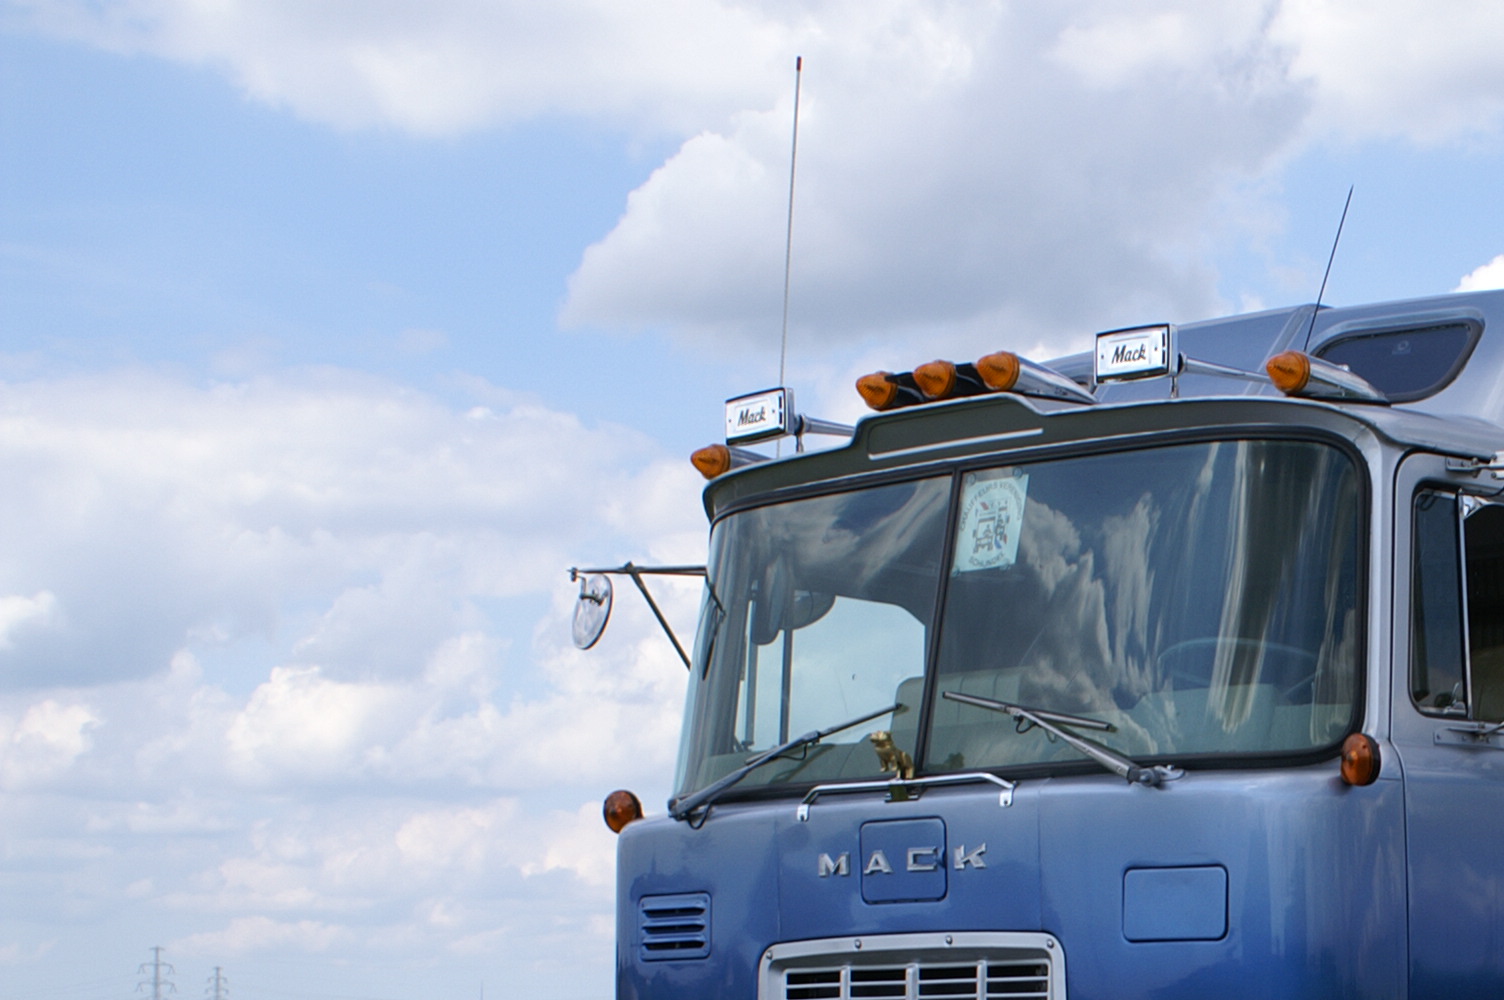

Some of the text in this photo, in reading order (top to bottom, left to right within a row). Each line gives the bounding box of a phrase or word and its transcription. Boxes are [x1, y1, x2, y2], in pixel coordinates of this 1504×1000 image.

[1111, 344, 1146, 365] Mack
[737, 406, 766, 427] Mack
[818, 842, 987, 877] MACK
